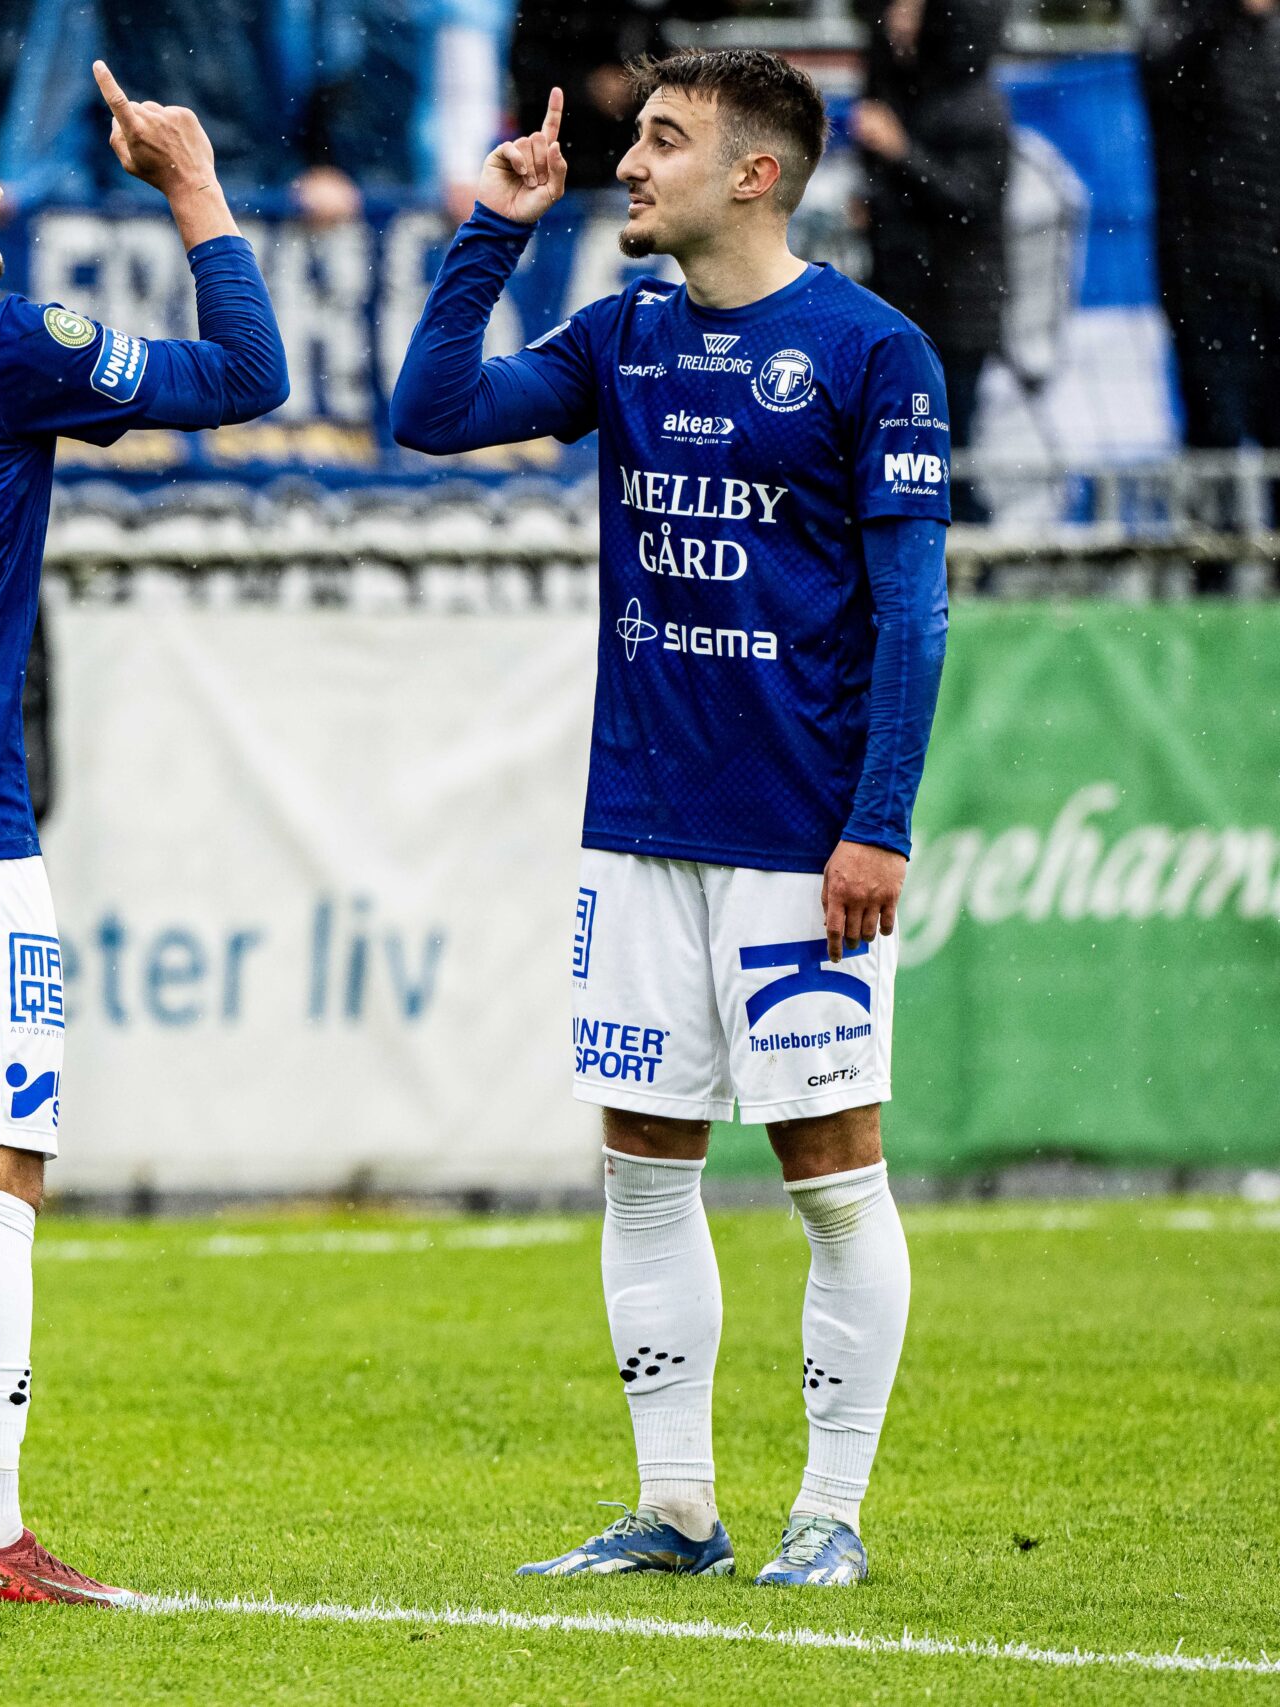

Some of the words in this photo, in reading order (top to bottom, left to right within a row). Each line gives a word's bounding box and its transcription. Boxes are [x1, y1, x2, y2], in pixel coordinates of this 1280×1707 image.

[100, 329, 129, 388] UNIBE
[618, 364, 657, 377] CRAFT
[677, 354, 753, 375] TRELLEBORG
[750, 377, 808, 413] TRELLEBORGS
[663, 409, 713, 435] akea
[879, 418, 909, 429] SPORTS
[911, 416, 932, 427] CLUB
[884, 452, 942, 483] MVB
[619, 465, 788, 524] MELLBY
[638, 521, 748, 581] GÅRD
[308, 892, 445, 1022] liv
[572, 1016, 665, 1055] INTER
[749, 1031, 831, 1052] Trelleborgs
[835, 1023, 871, 1041] Hamn
[575, 1046, 663, 1083] SPORT
[807, 1068, 849, 1087] CRAFT
